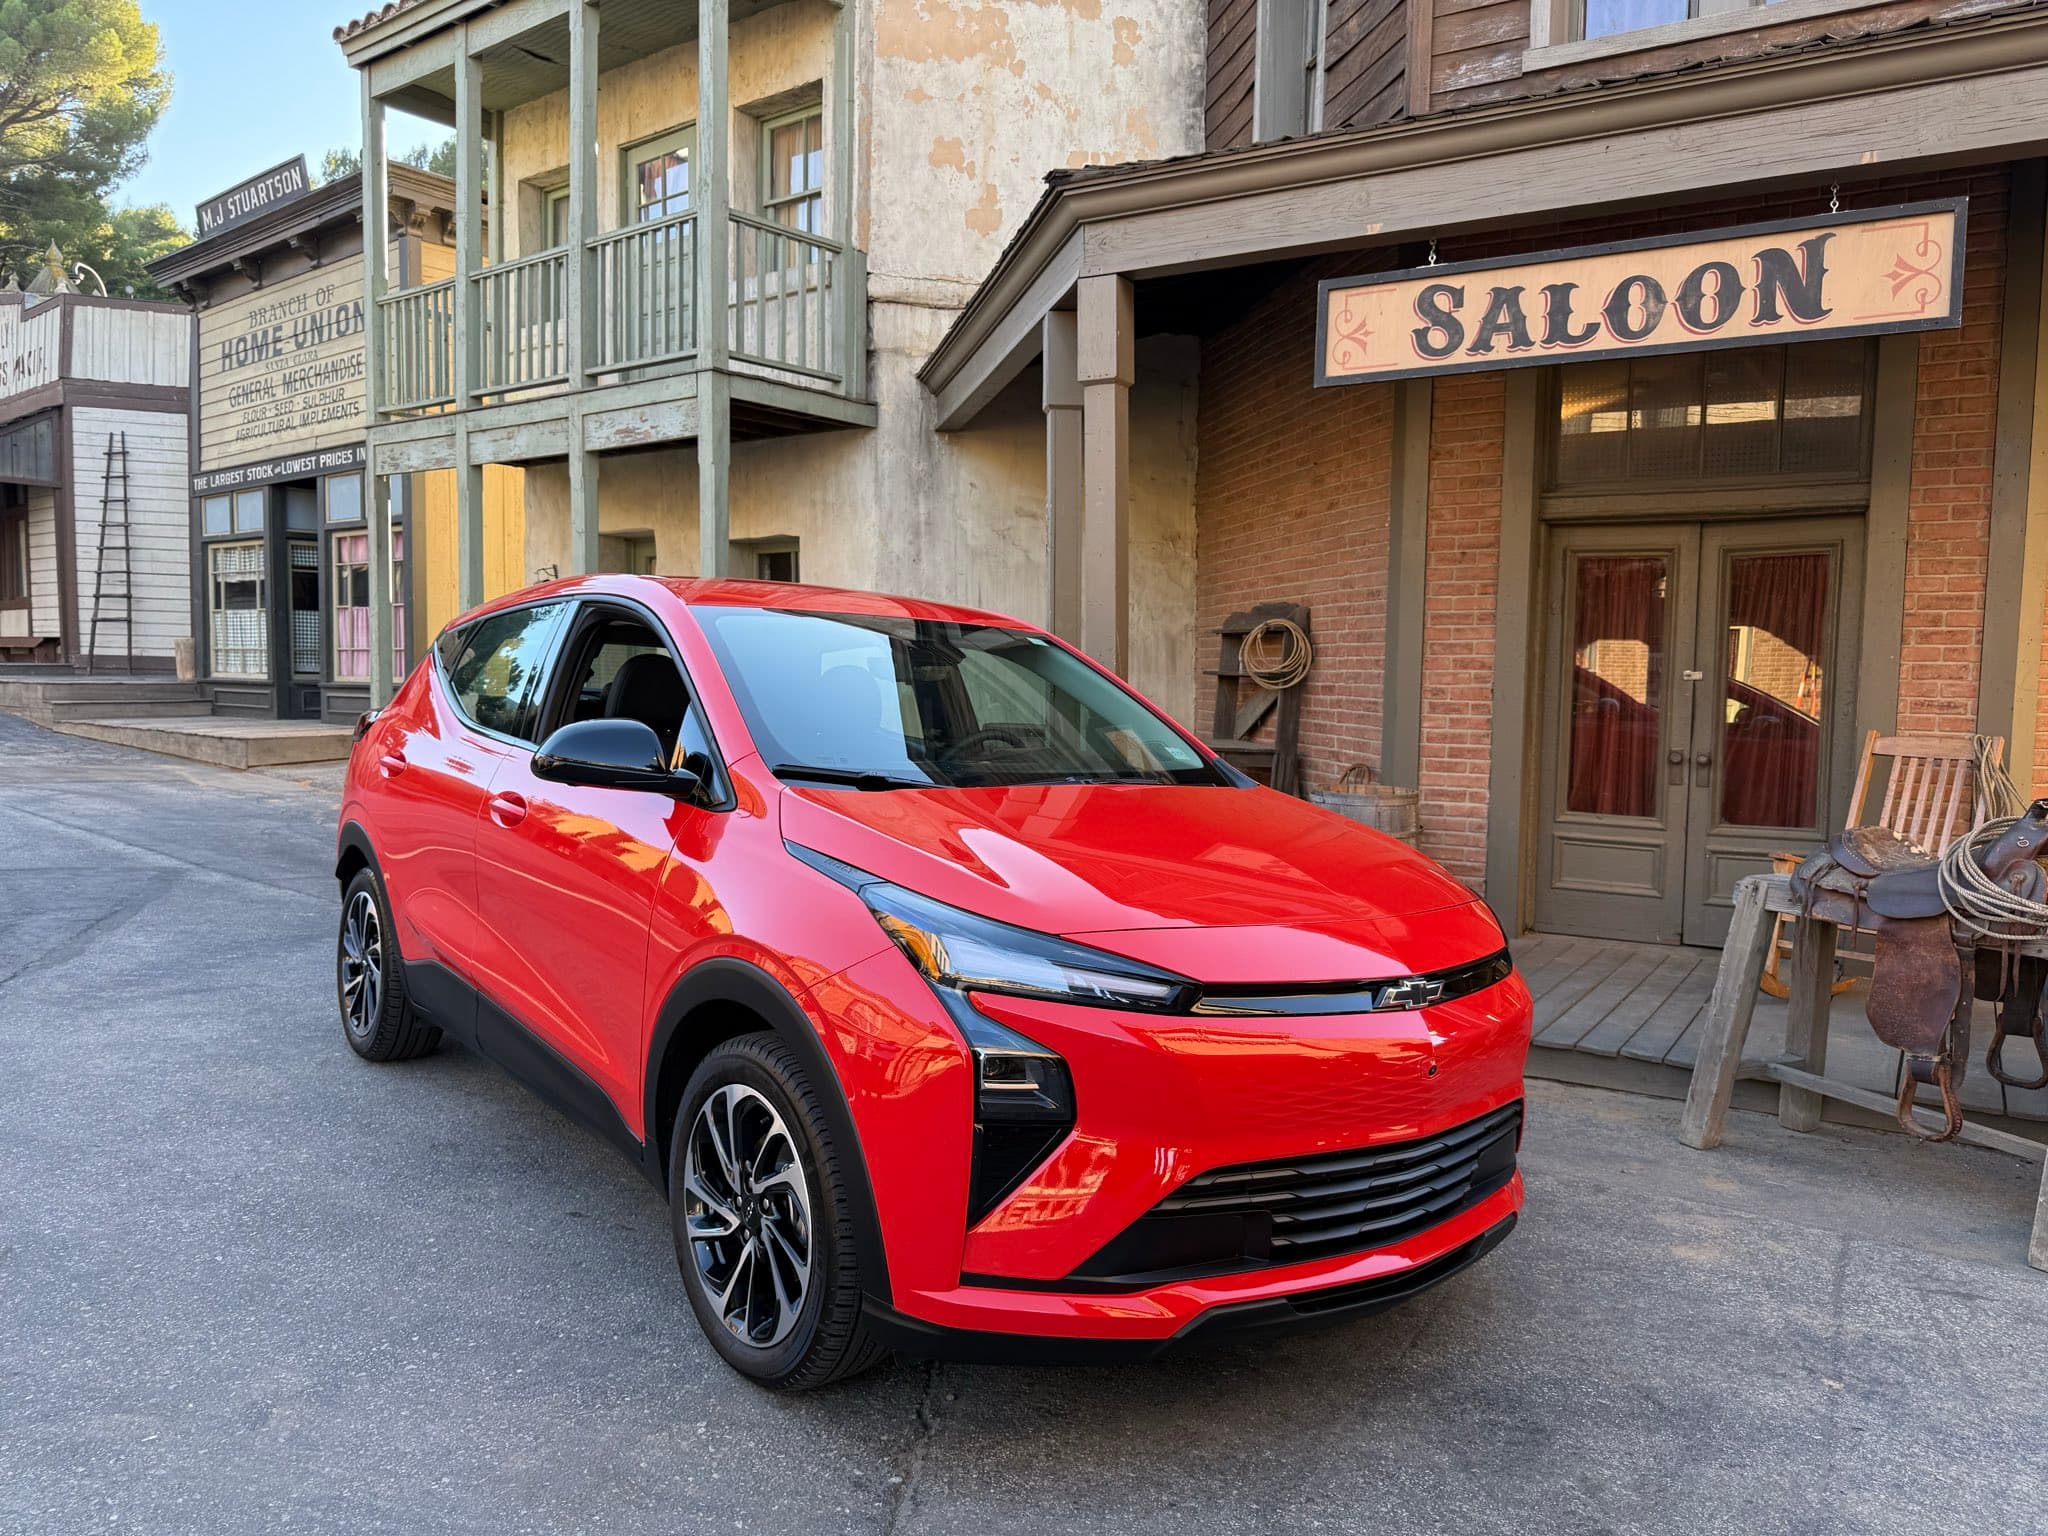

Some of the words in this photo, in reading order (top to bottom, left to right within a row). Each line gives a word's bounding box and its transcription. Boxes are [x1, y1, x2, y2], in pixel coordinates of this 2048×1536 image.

[227, 166, 303, 219] STUARTSON
[249, 293, 308, 329] BRANCH
[315, 284, 335, 306] OF
[1411, 232, 1837, 361] SALOON
[221, 325, 283, 372] HOME
[293, 299, 364, 350] UNION
[293, 349, 319, 366] CLARA
[229, 377, 276, 408] GENERAL
[282, 353, 363, 395] MERCHANDISE
[236, 415, 296, 442] AGRICULTURAL
[301, 401, 360, 426] IMPLEMENTS
[242, 406, 267, 424] FLOUR
[274, 400, 294, 416] SEED
[303, 387, 345, 409] SULPHUR
[193, 478, 208, 491] THE
[210, 470, 244, 487] LARGEST
[247, 465, 274, 481] STOCK
[281, 457, 317, 474] LOWEST
[320, 450, 353, 468] PRICES
[356, 448, 366, 461] IN
